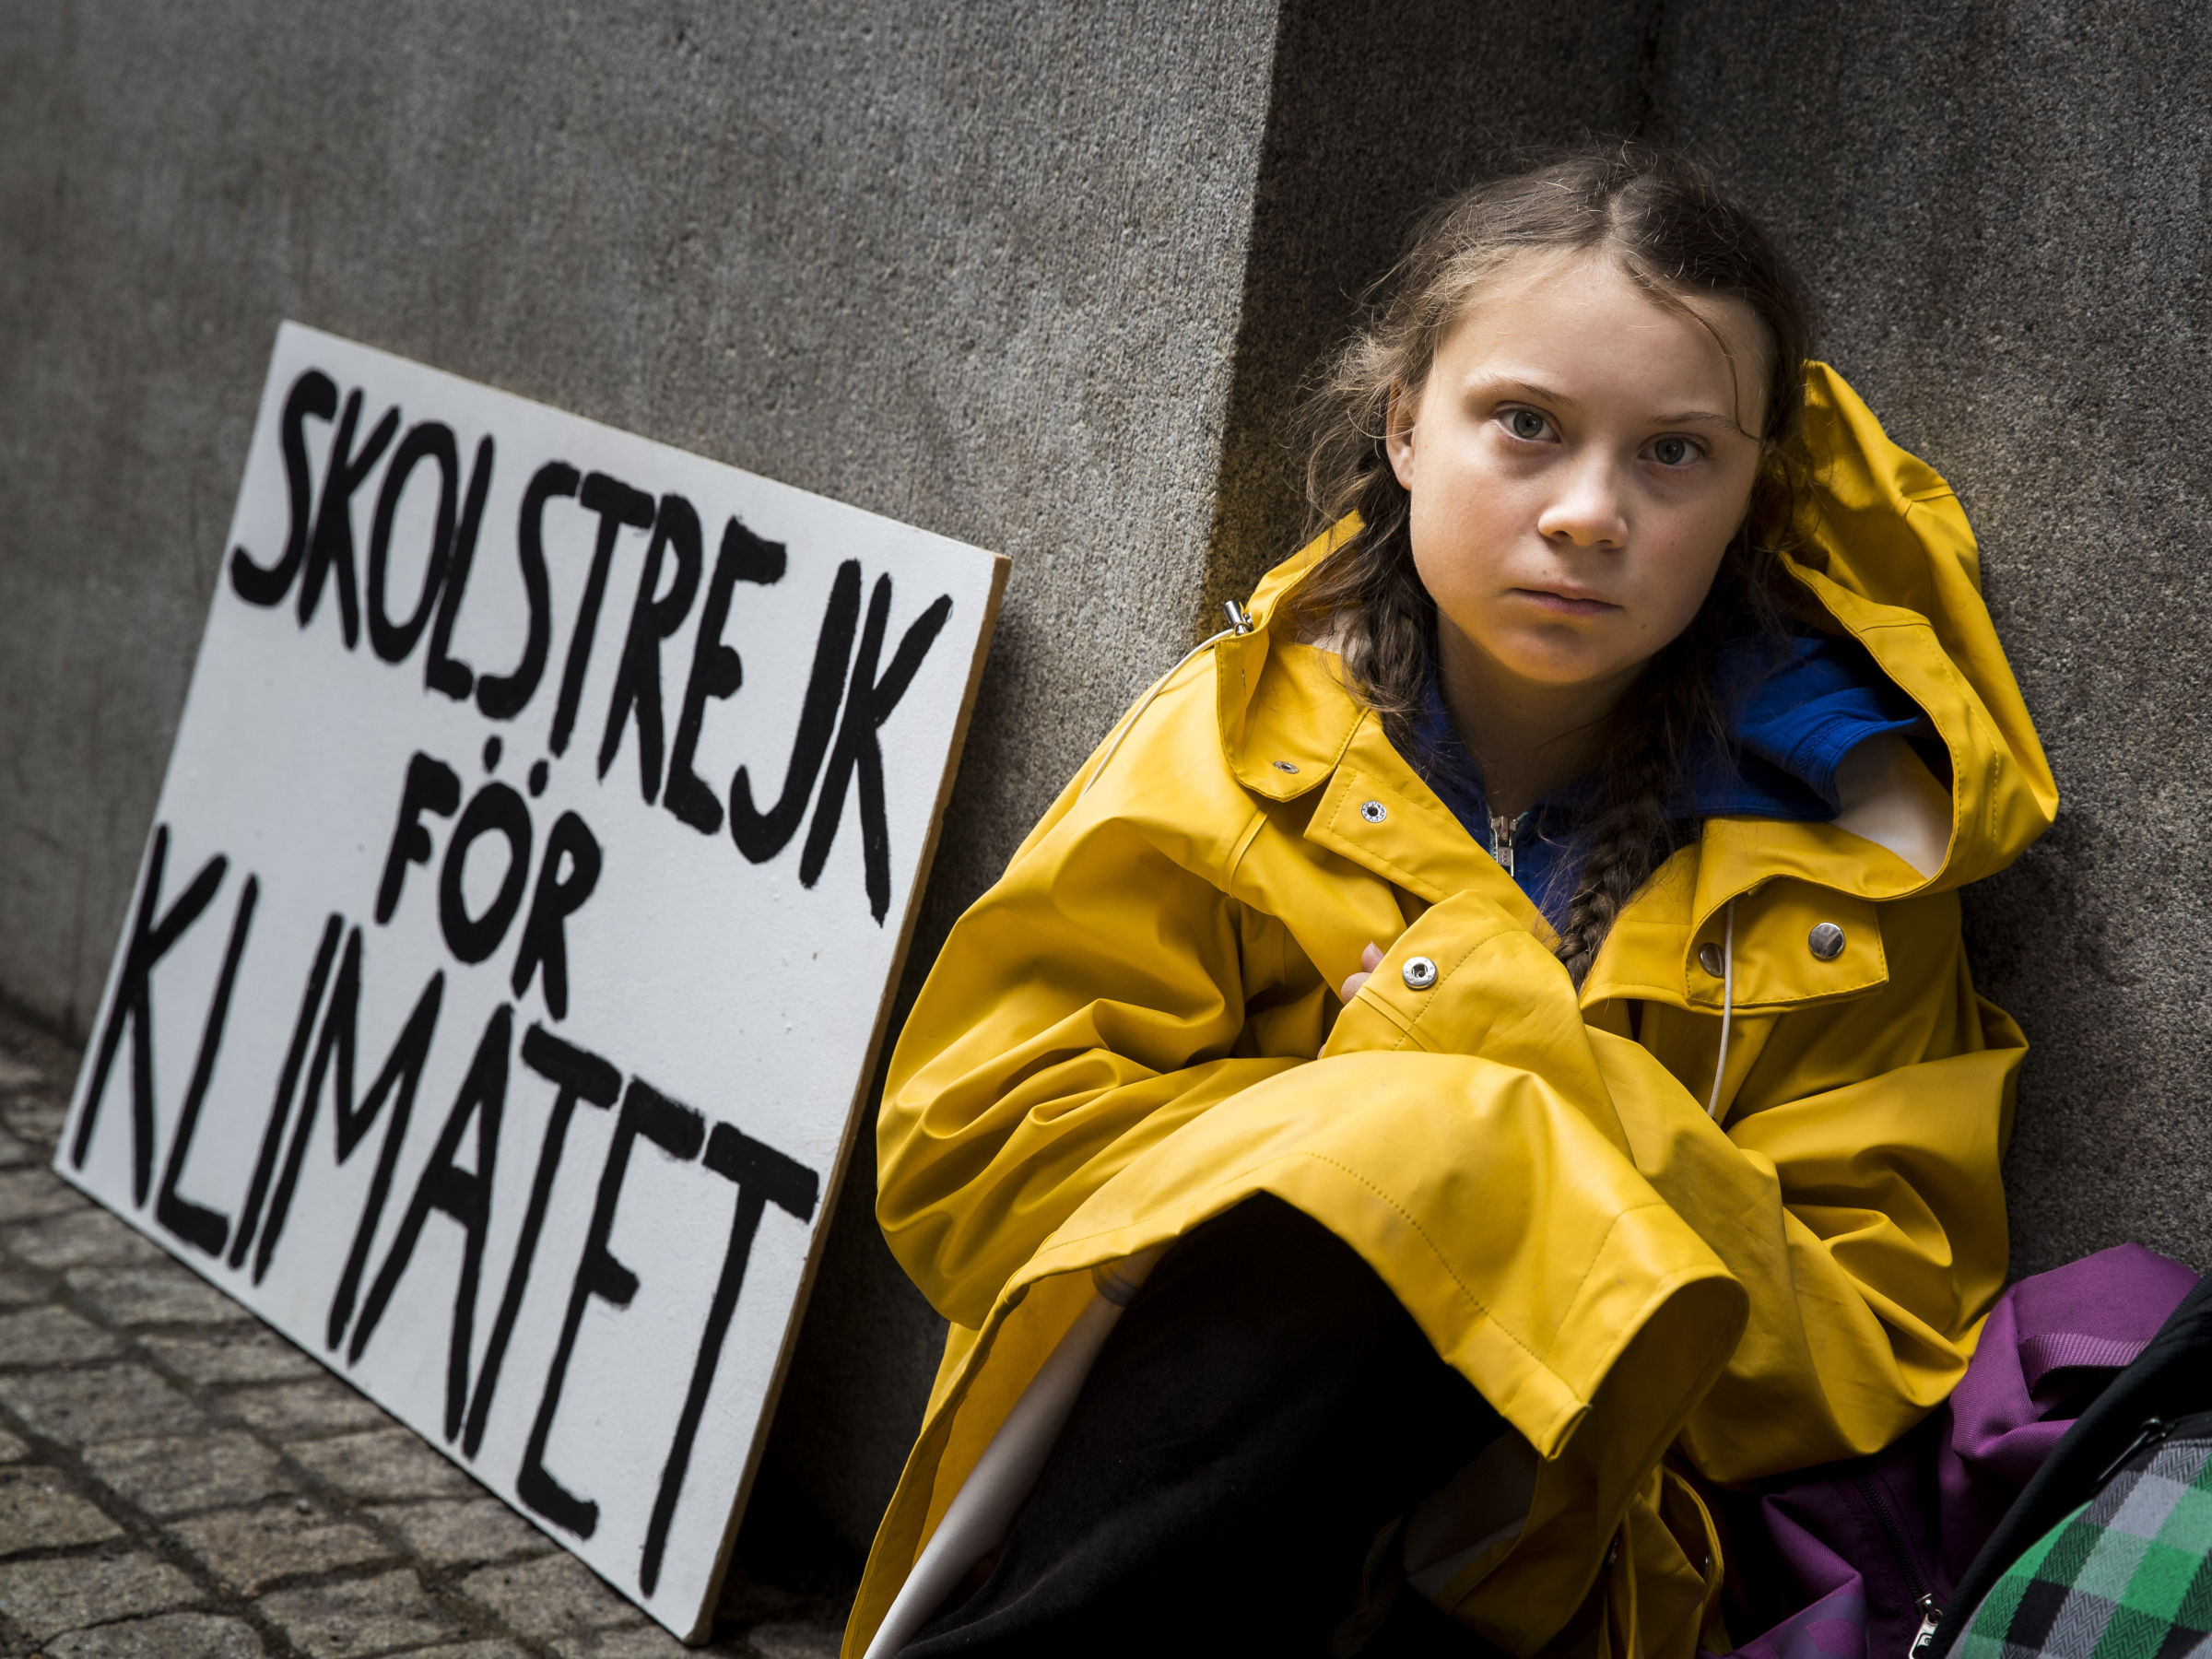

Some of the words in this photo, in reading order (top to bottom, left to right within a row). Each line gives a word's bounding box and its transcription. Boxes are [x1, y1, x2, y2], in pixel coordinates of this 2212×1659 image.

[229, 369, 954, 928] SKOLSTREJK
[374, 735, 604, 1023] FÖR
[71, 824, 819, 1600] KLIMATET
